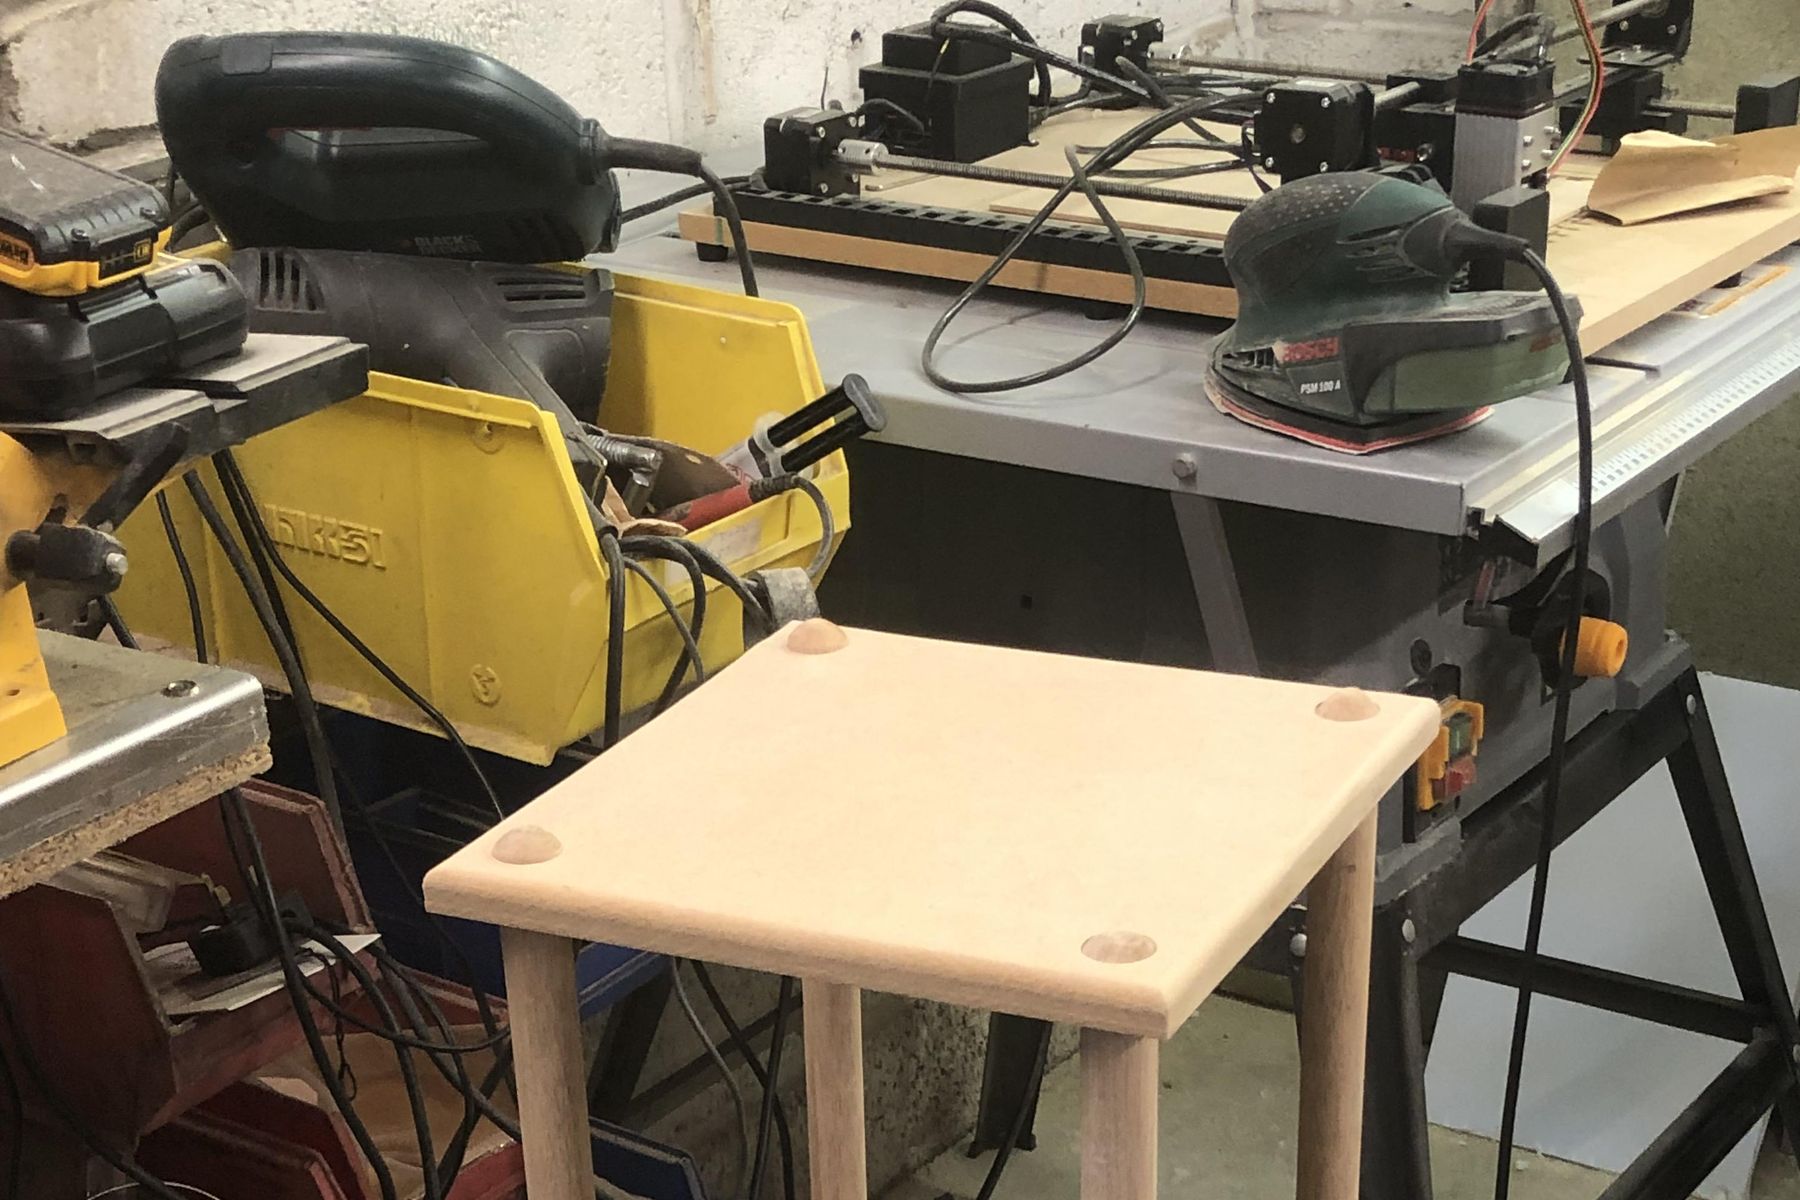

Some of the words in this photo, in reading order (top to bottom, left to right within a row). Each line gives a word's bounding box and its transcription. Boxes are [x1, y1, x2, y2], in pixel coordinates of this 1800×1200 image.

[1300, 382, 1318, 395] PSM
[1318, 380, 1334, 393] 100
[1334, 379, 1341, 391] A
